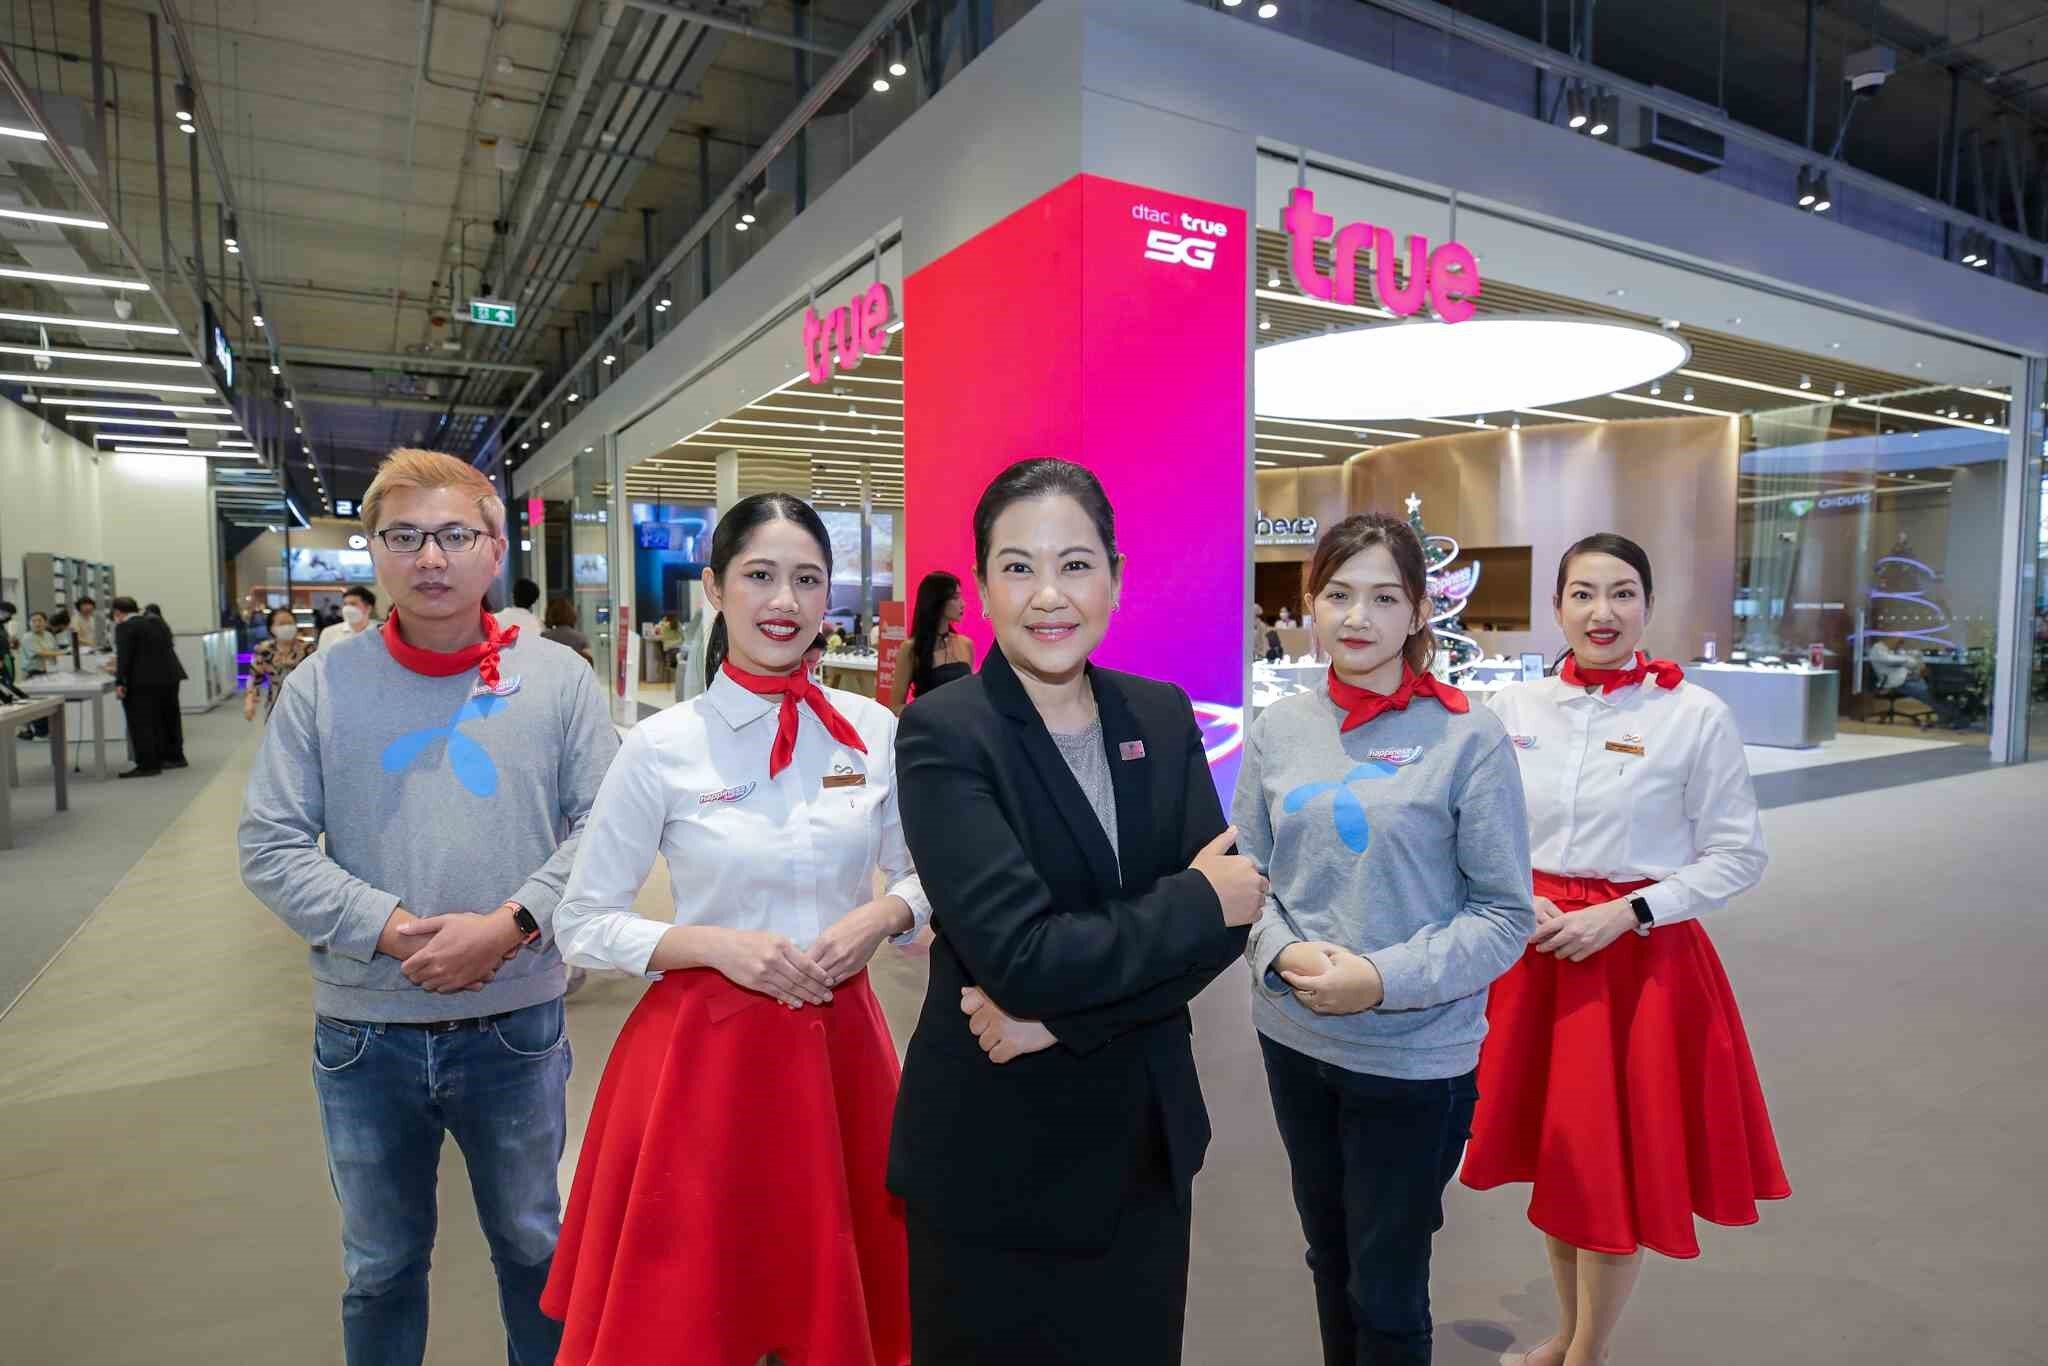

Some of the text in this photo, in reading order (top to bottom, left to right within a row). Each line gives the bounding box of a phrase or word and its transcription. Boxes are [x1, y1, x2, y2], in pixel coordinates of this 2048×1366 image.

[1131, 203, 1228, 238] dtac true
[1143, 228, 1217, 271] 5G
[1281, 187, 1481, 324] true
[803, 281, 894, 384] true
